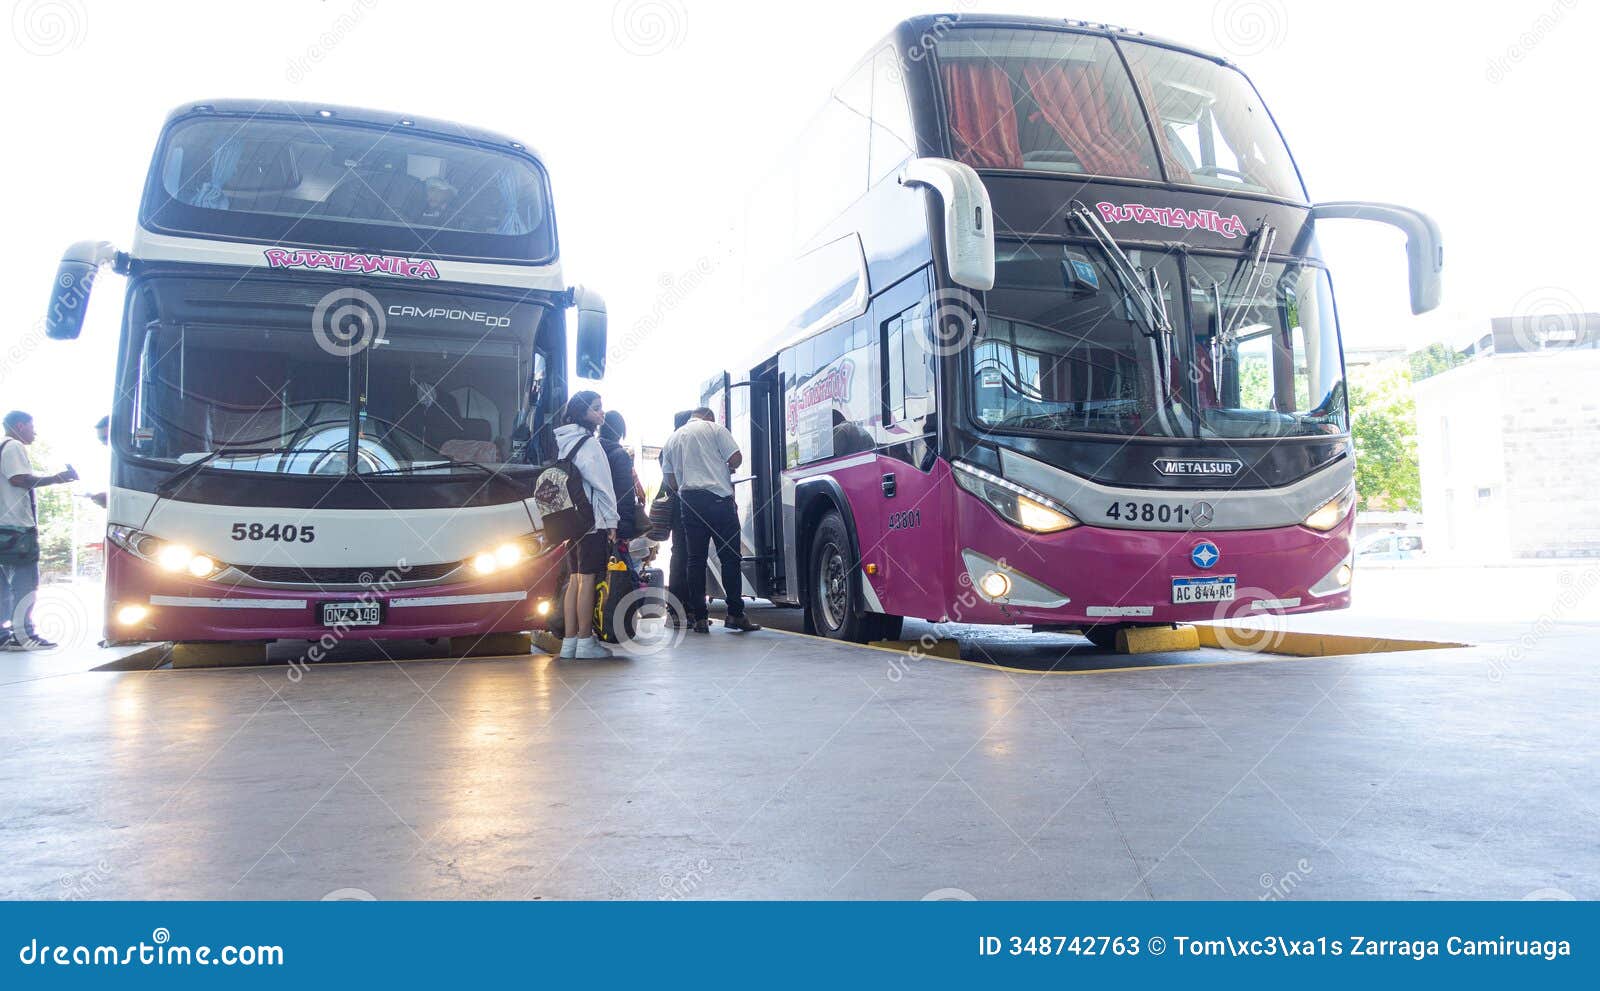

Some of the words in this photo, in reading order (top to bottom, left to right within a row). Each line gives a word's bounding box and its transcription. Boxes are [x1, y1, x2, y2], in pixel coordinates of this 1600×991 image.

[1096, 202, 1248, 239] RUTATLANTICA
[264, 249, 440, 279] RUTATLANTICA
[1165, 462, 1232, 474] METALSUR
[1106, 501, 1184, 523] 43801
[231, 523, 315, 543] 58405
